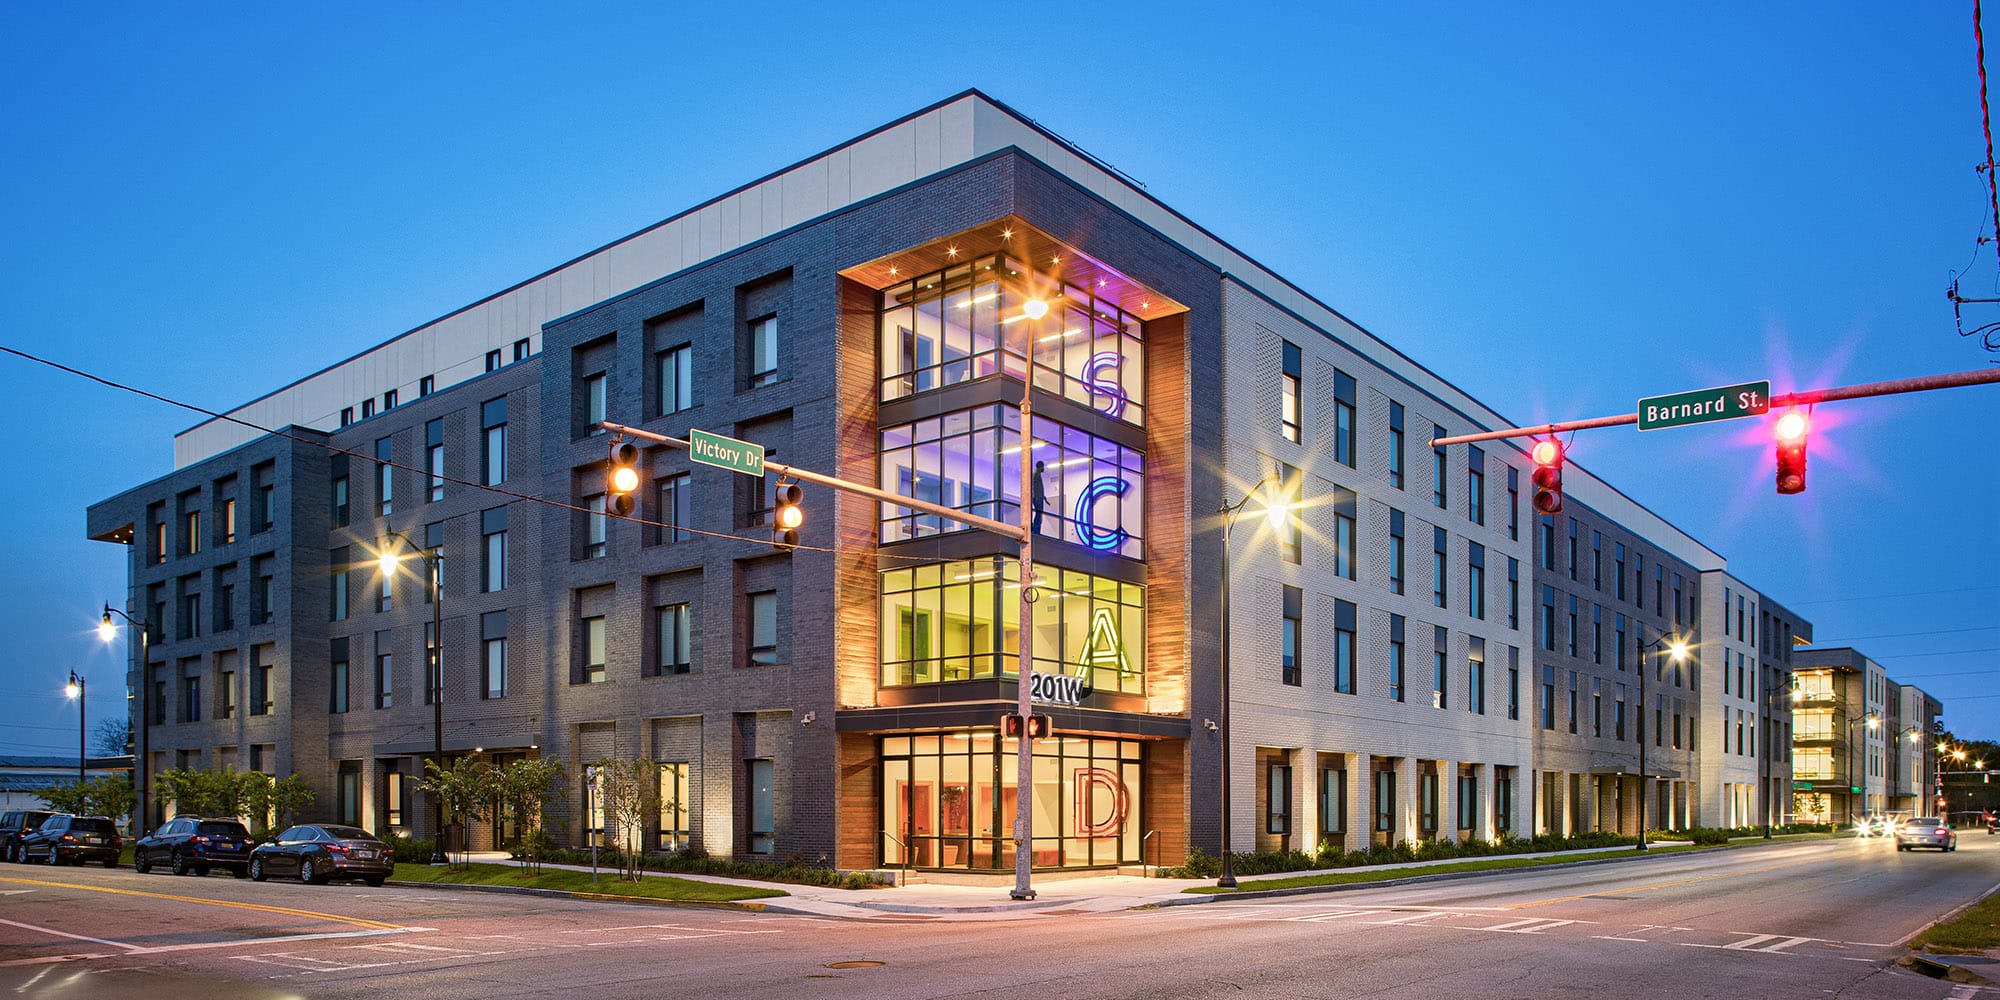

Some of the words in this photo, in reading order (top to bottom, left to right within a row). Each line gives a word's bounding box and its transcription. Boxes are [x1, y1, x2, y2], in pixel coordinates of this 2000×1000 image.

[1647, 395, 1725, 422] Barnard
[1738, 391, 1764, 409] St.
[695, 438, 740, 465] Victory
